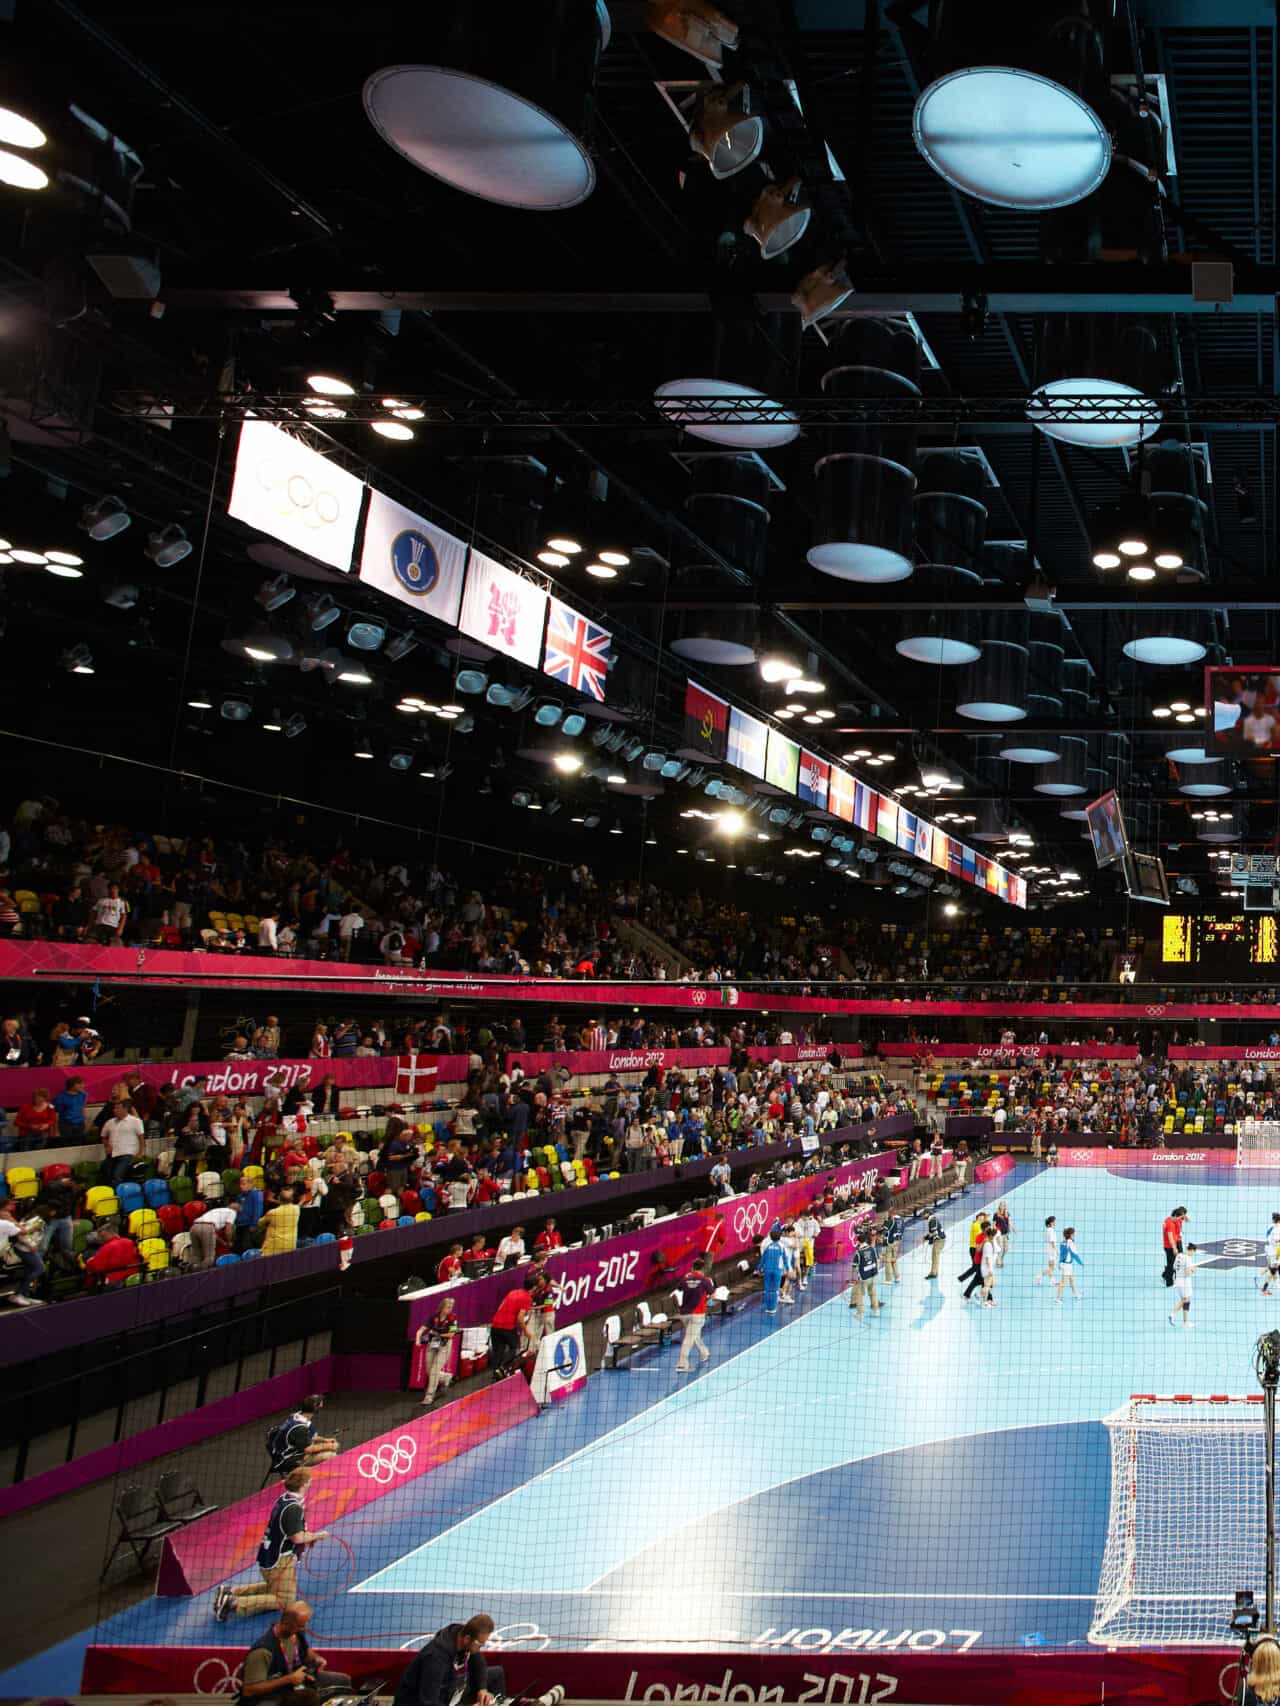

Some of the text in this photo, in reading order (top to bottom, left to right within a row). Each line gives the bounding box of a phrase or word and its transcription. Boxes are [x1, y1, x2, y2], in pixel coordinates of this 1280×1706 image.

[609, 1051, 644, 1069] London
[1152, 1151, 1206, 1161] London 2012
[552, 1250, 640, 1310] don 2012
[750, 1627, 984, 1654] London
[623, 1668, 899, 1706] London 2012
